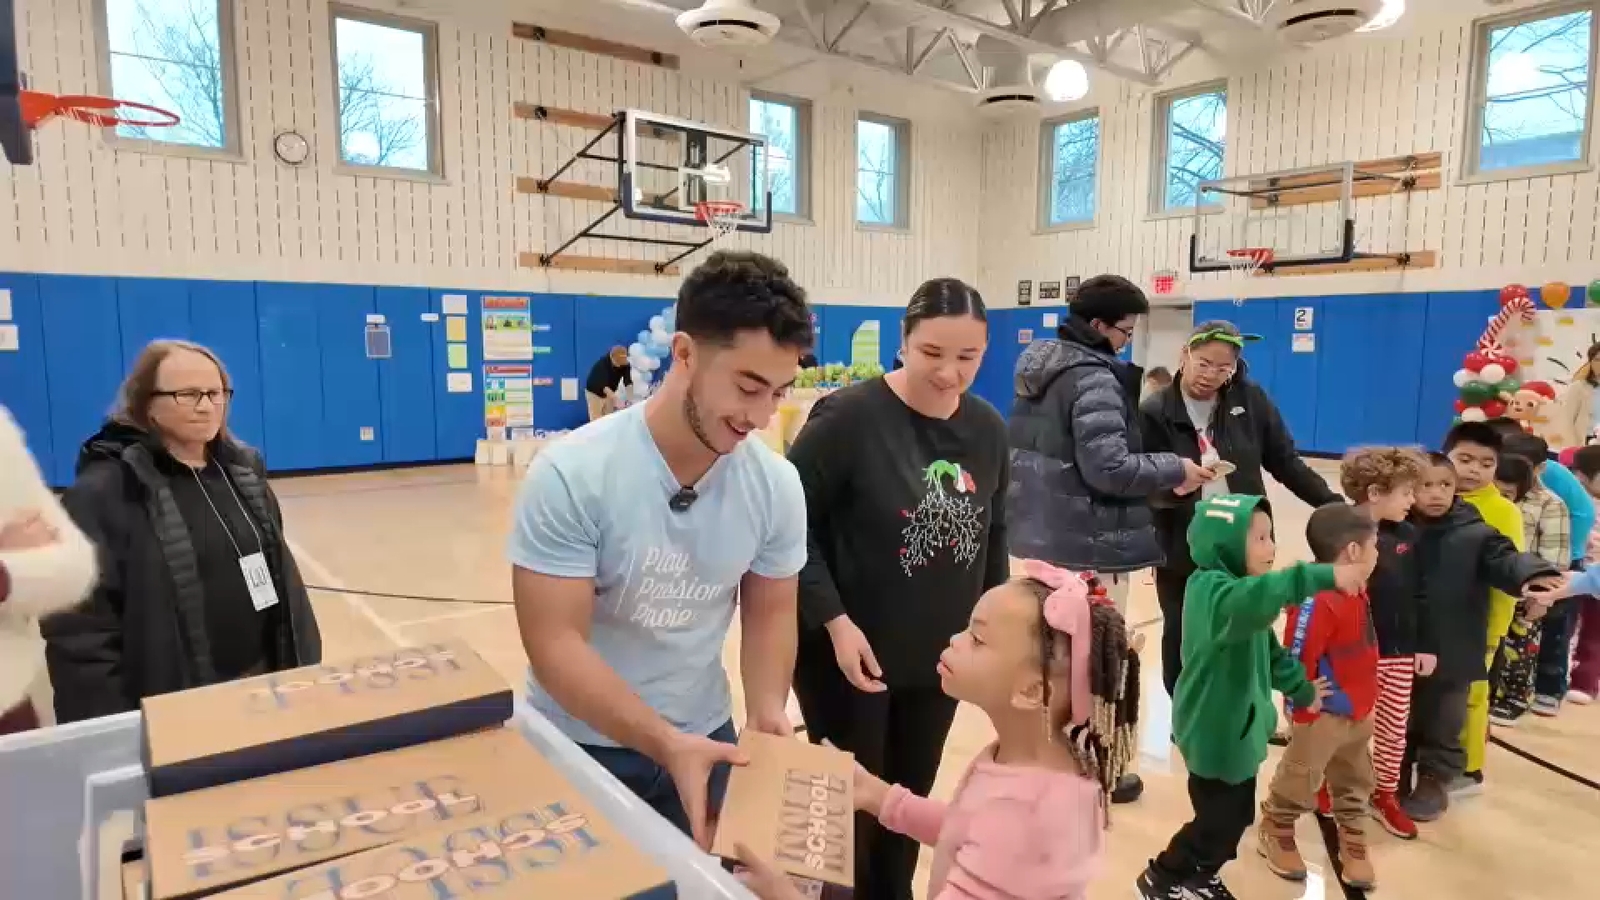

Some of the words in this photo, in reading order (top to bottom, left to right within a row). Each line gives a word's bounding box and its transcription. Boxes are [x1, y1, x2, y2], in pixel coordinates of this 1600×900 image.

[1296, 309, 1306, 323] 2
[184, 792, 478, 865] SCHOOL
[804, 773, 831, 871] SCHOOL
